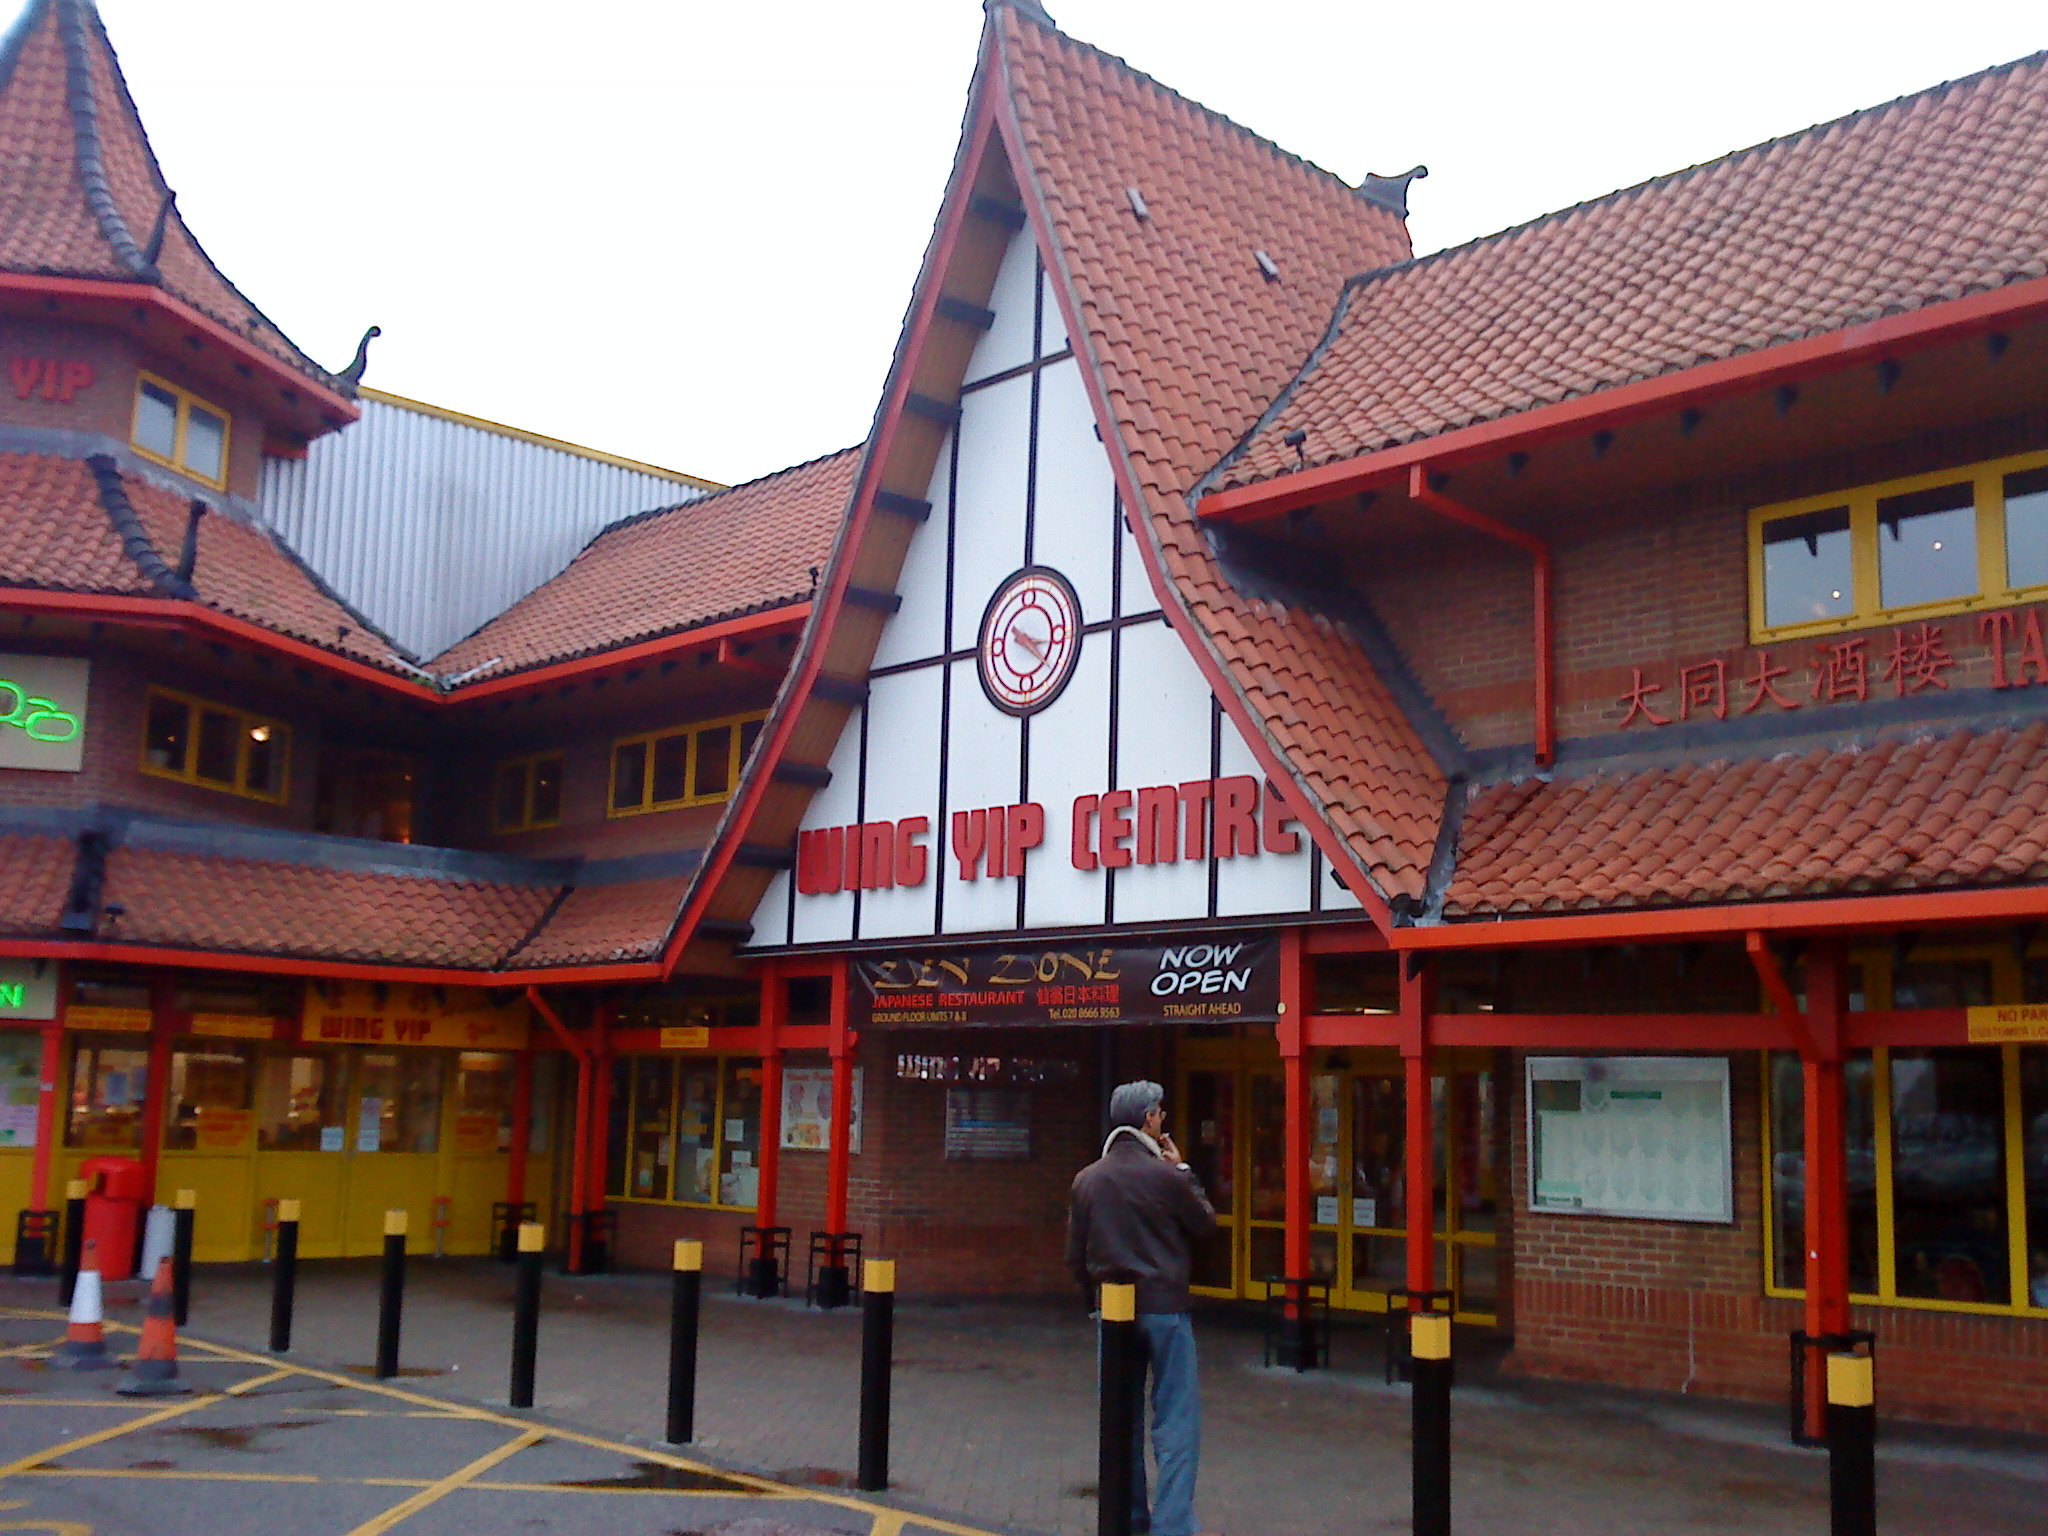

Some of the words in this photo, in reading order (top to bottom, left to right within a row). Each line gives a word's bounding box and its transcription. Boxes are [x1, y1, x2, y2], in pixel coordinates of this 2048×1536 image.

[1620, 623, 1955, 728] 大同大酒楼
[797, 816, 928, 895] WING
[952, 803, 1045, 881] YIP
[1071, 775, 1299, 870] CENTRE
[872, 956, 970, 988] ZEN
[989, 949, 1121, 984] ZONE
[1160, 942, 1243, 970] NOW
[1151, 967, 1251, 996] OPEN
[872, 994, 934, 1008] JAPANESE
[938, 990, 1025, 1007] RESTAURANT
[1163, 1004, 1207, 1017] STRAIGHT
[1208, 1002, 1242, 1015] AHEAD
[320, 1017, 384, 1040] WING
[872, 1012, 901, 1023] GROUND
[903, 1012, 926, 1022] FLOOR
[927, 1011, 947, 1021] UNITS
